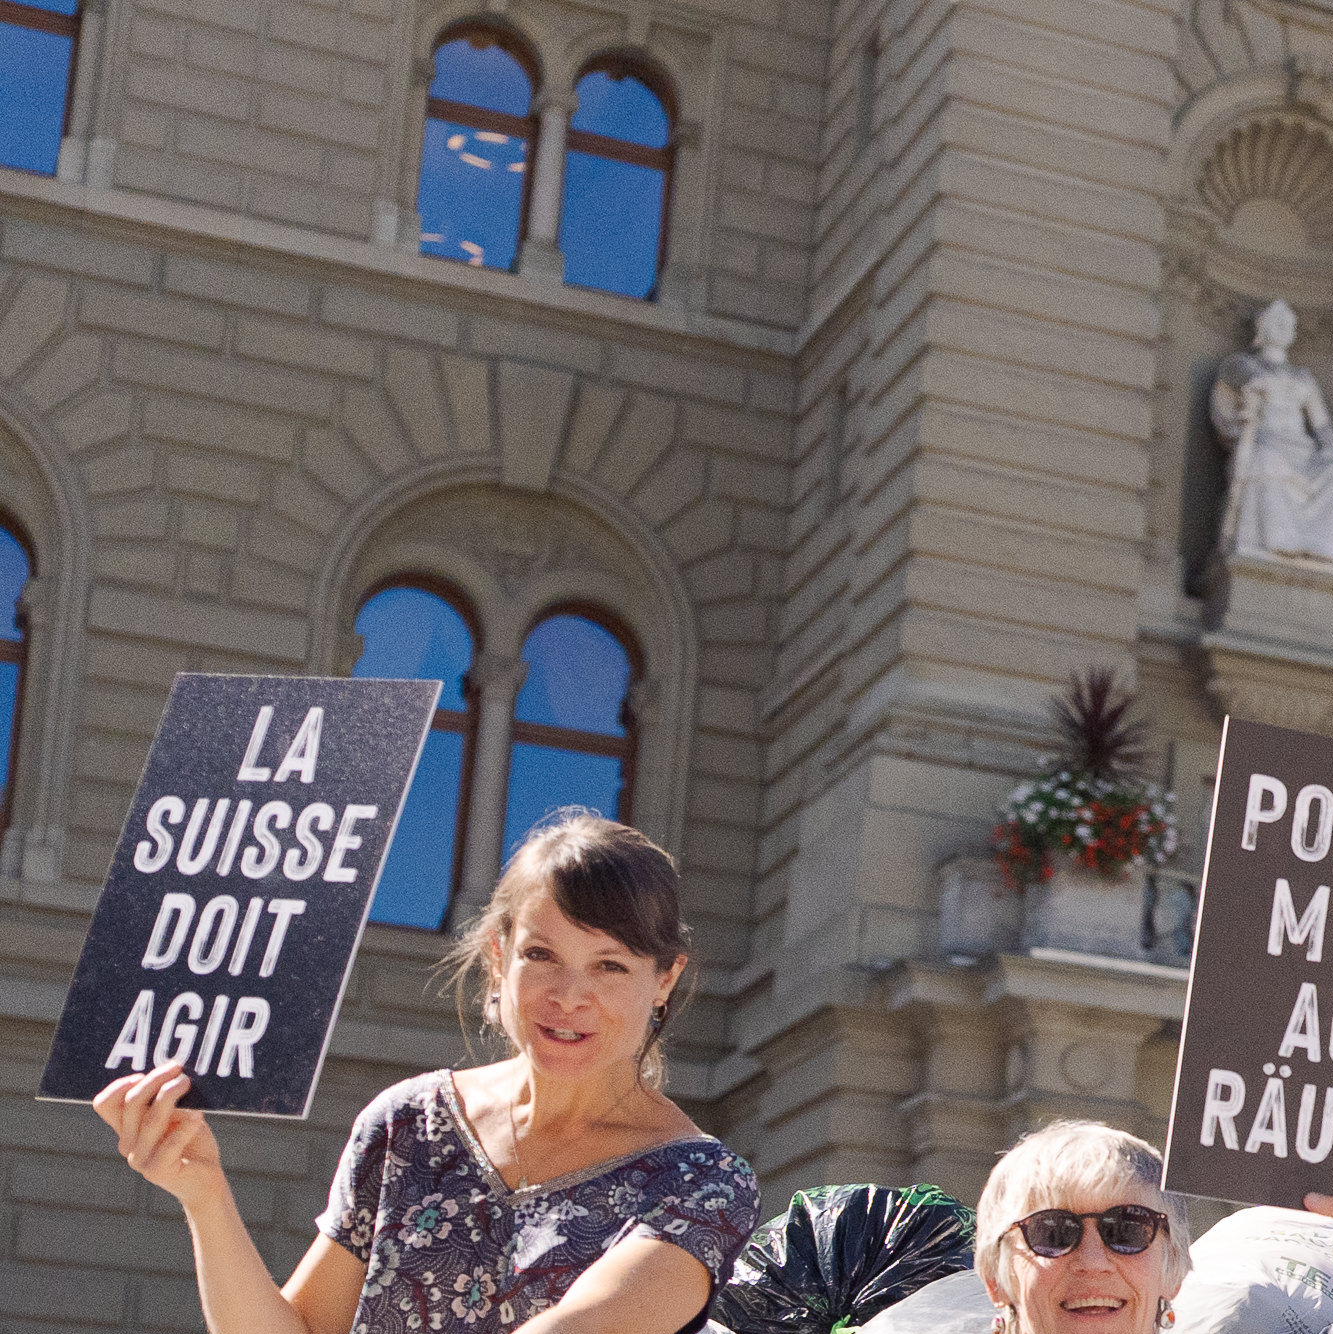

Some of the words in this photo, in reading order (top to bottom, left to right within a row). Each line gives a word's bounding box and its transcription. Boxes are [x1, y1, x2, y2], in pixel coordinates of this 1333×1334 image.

[237, 704, 324, 784] LA
[134, 796, 378, 883] SUISSE
[142, 892, 306, 977] DOIT
[105, 990, 271, 1079] AGIR
